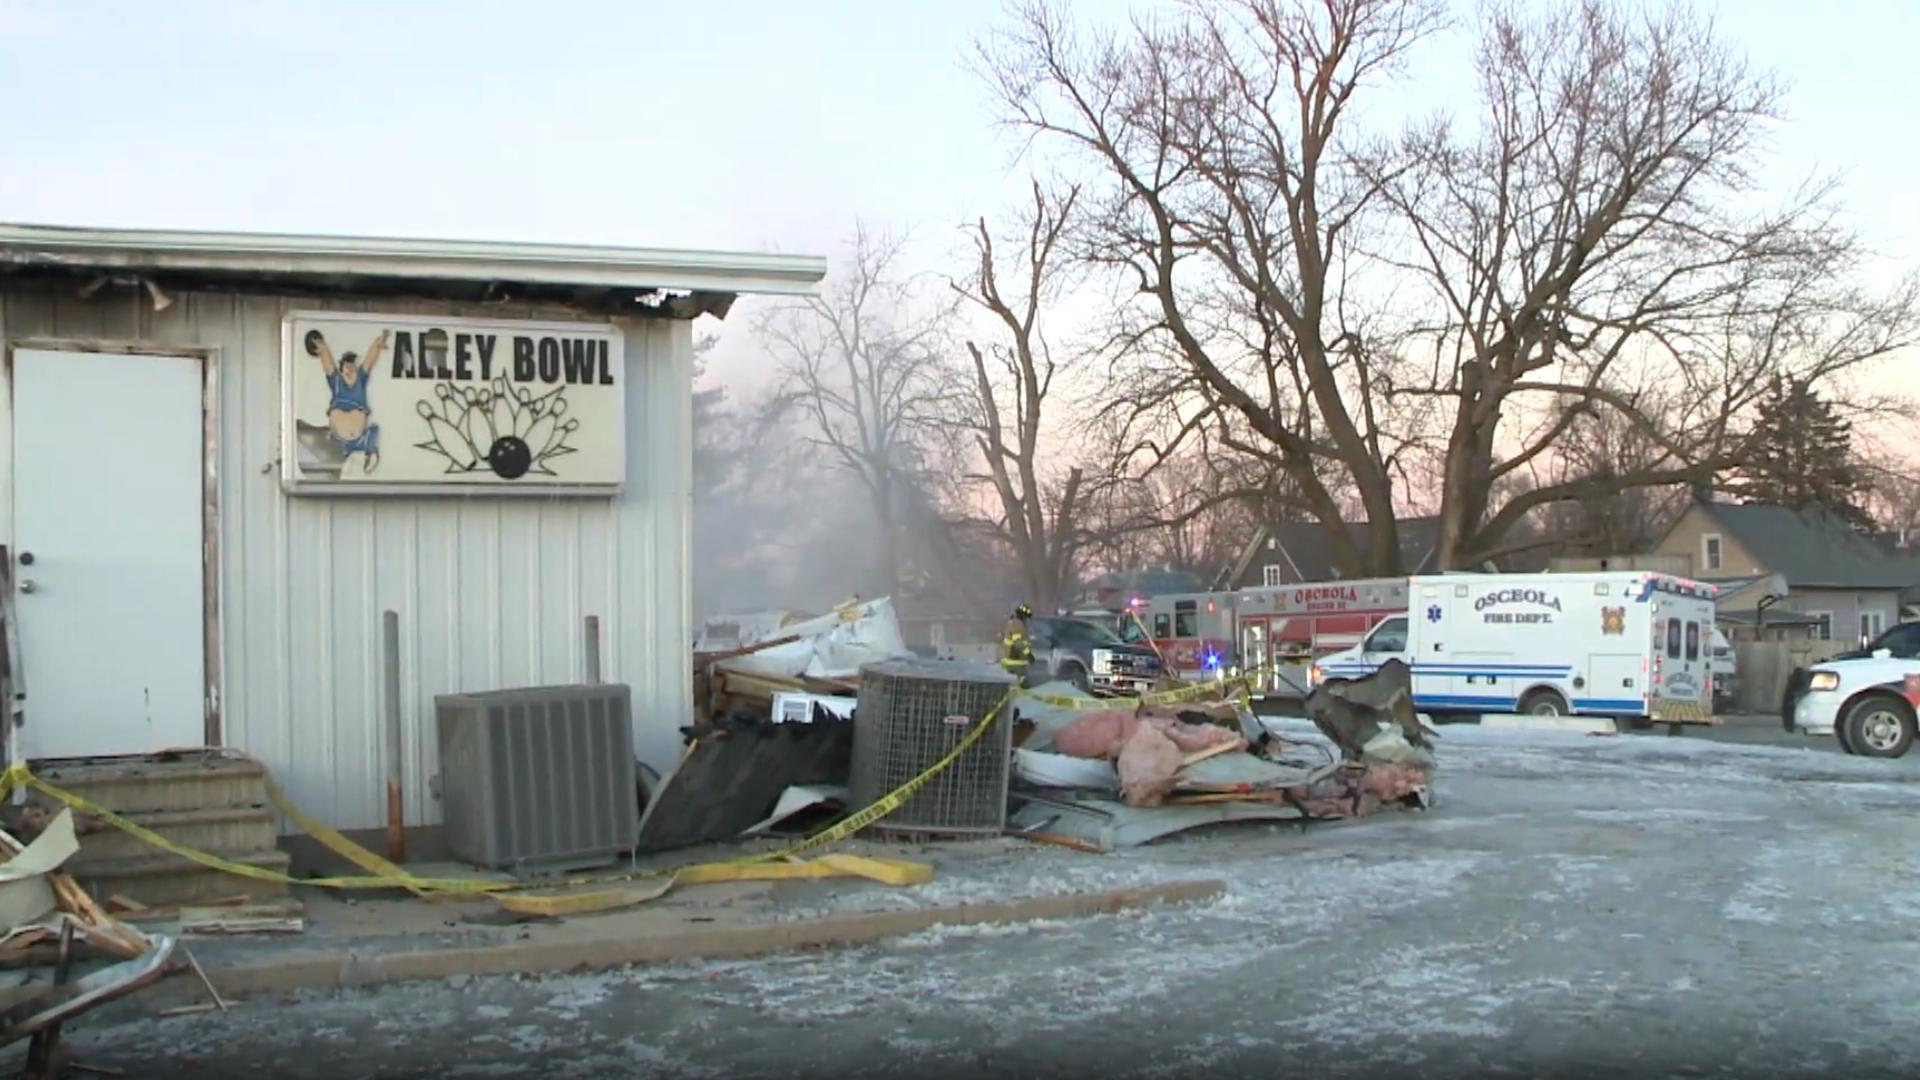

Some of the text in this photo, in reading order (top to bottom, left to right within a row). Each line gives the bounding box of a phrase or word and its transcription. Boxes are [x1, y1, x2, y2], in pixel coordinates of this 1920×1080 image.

[513, 336, 614, 385] BOWL
[1474, 588, 1562, 612] OSCEOLA
[1483, 613, 1513, 624] FIRE
